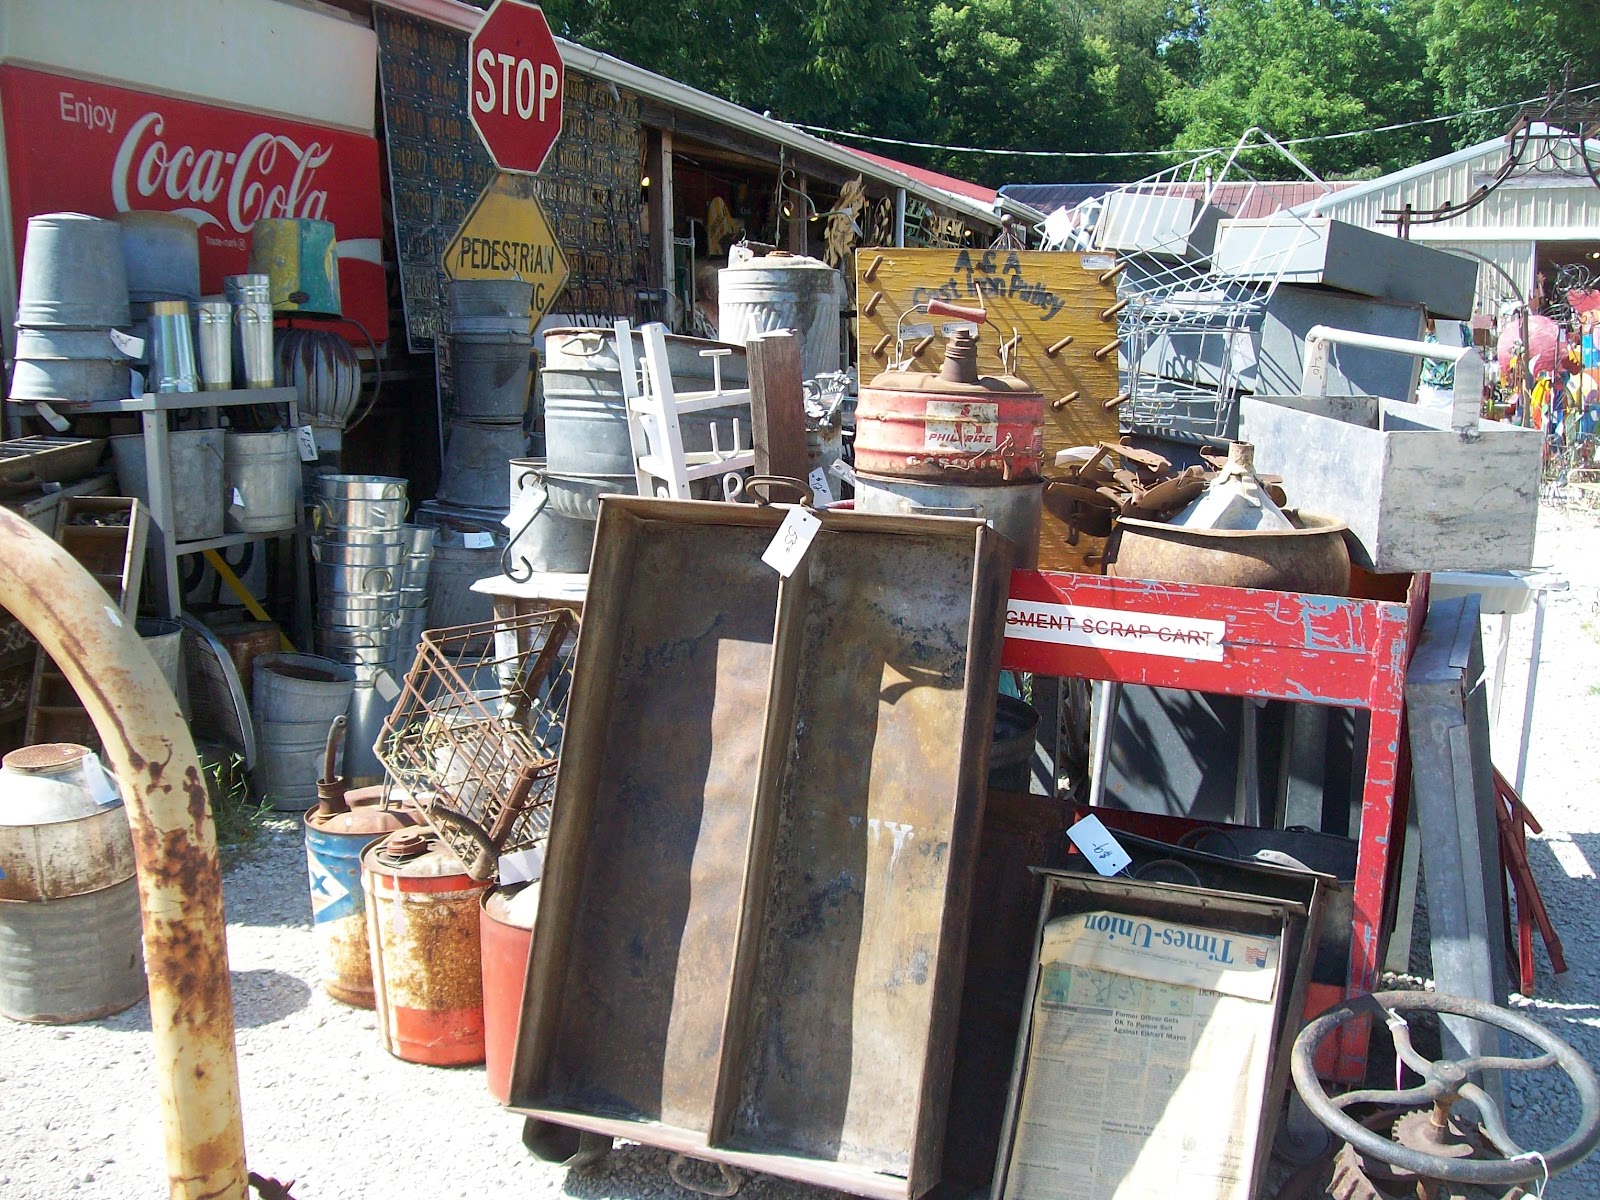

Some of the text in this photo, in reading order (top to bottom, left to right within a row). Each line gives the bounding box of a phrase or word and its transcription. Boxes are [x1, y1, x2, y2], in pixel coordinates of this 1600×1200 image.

[475, 48, 559, 122] STOP
[59, 91, 117, 134] Enjoy
[111, 112, 333, 234] Coca-Cola
[460, 236, 554, 275] PEDESTRIAN
[952, 250, 974, 274] A
[1002, 251, 1022, 275] A
[964, 434, 994, 444] RITE
[1006, 610, 1214, 647] GMENT SCRAP CART
[1083, 914, 1234, 965] Times-Union
[1114, 1018, 1124, 1026] OK
[1136, 1021, 1158, 1030] Pursue
[1160, 1024, 1173, 1032] Suit
[1114, 1026, 1187, 1042] Against Elkhart Mayor
[1115, 1010, 1179, 1024] Former Officer Gets
